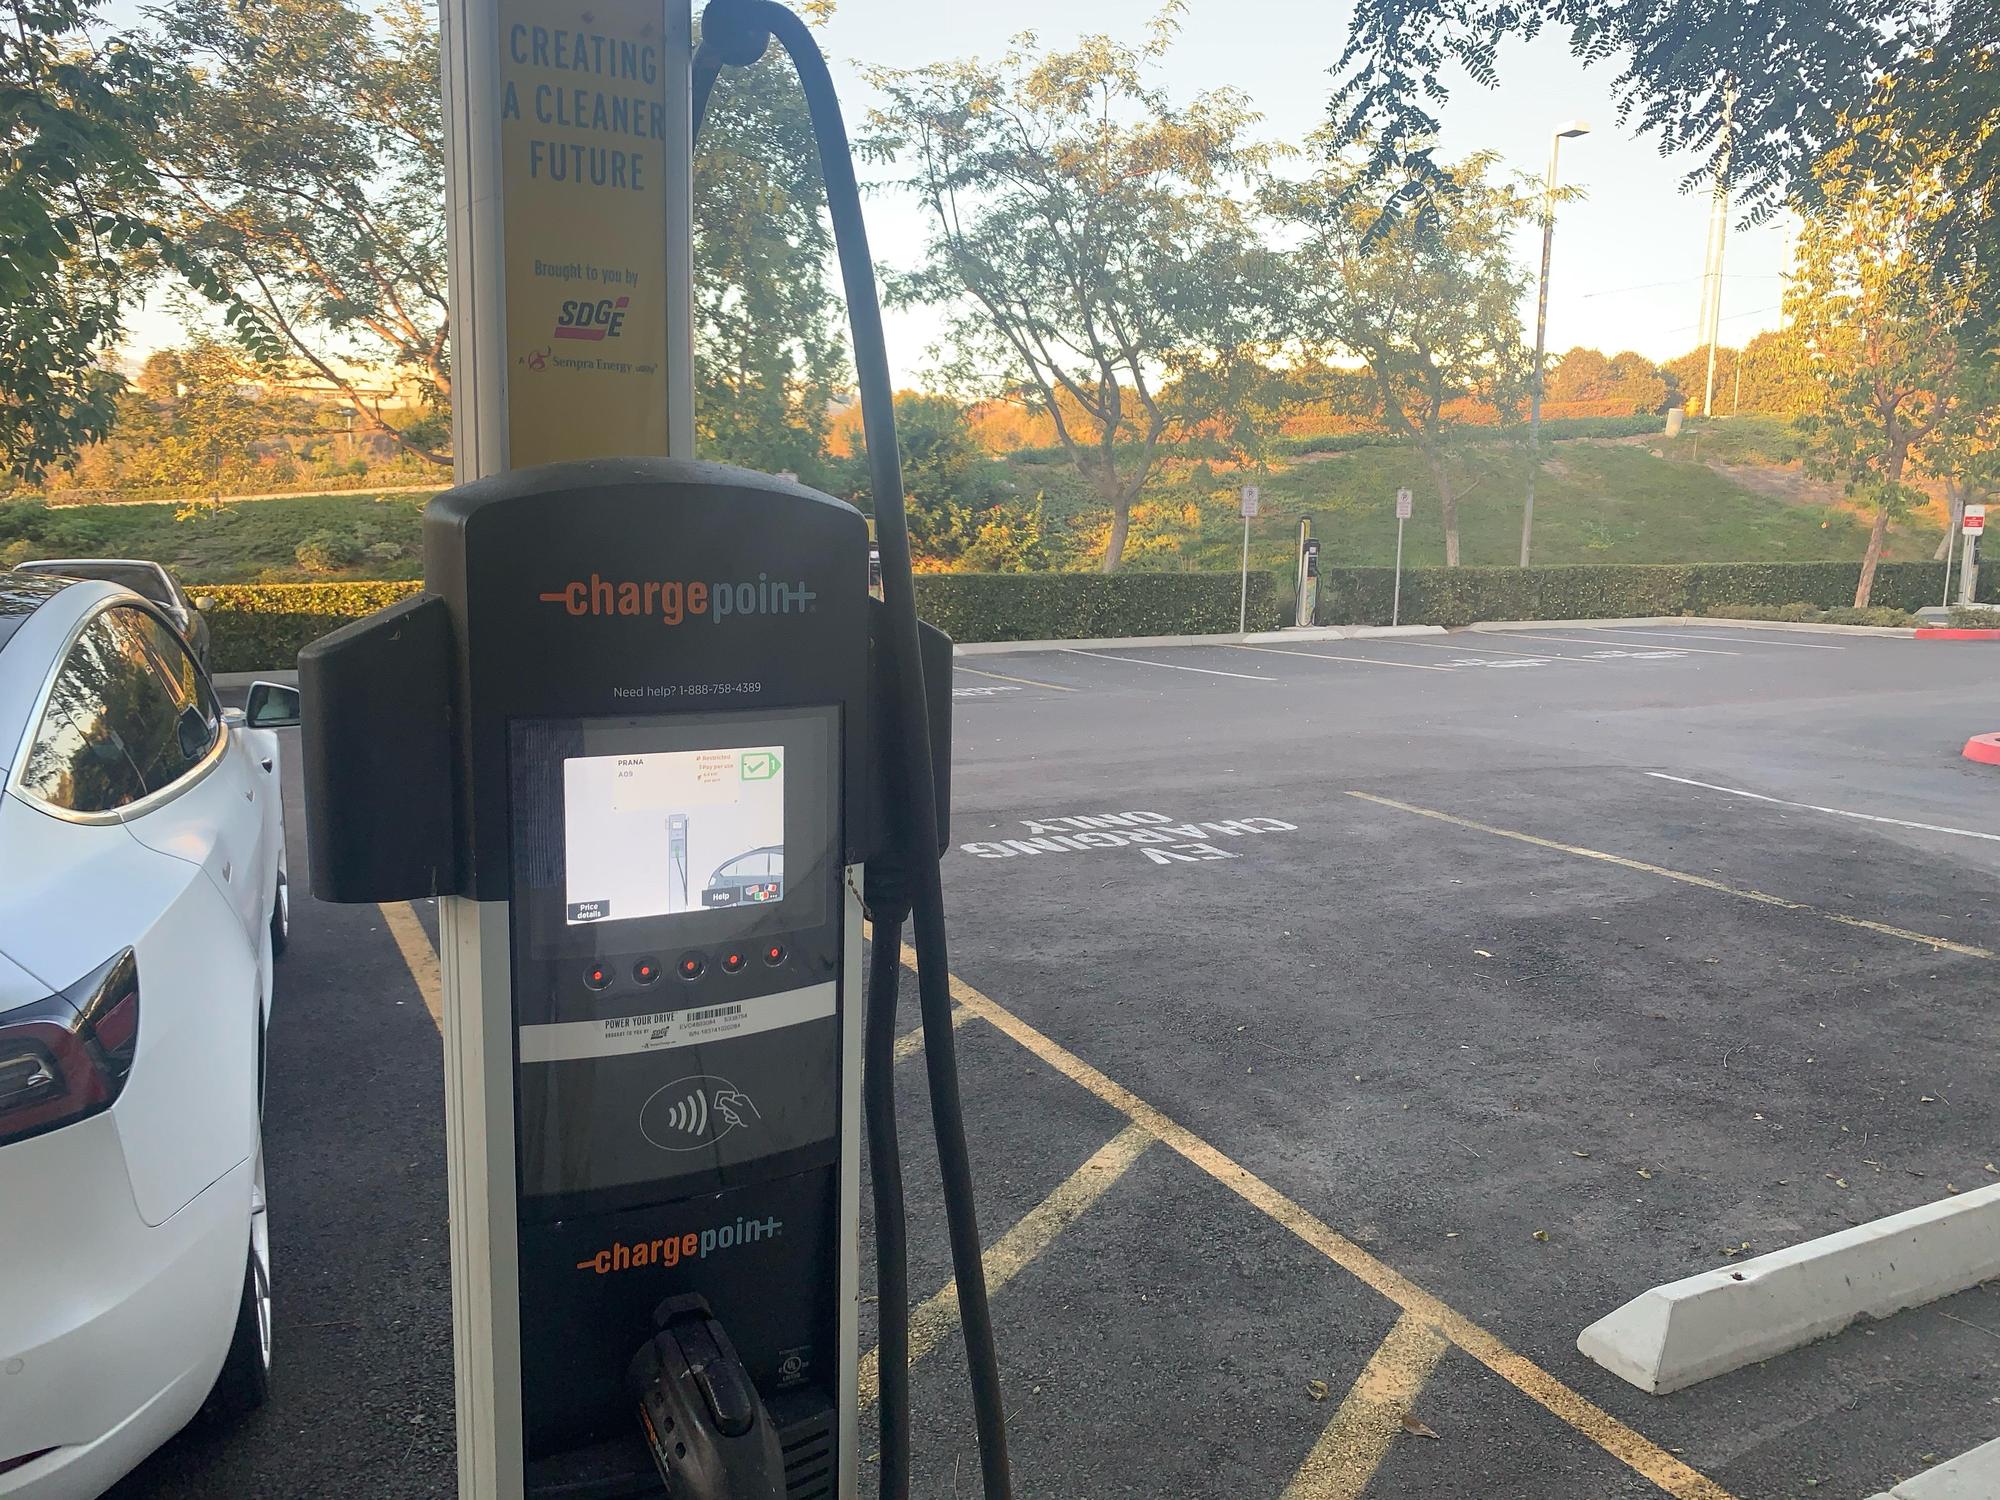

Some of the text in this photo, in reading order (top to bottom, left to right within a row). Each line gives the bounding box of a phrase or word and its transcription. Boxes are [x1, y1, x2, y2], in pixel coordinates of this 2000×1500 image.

[511, 23, 657, 85] CREATING
[502, 81, 665, 141] A CLEANER
[531, 140, 644, 191] FUTURE
[535, 260, 639, 288] Brought to you by
[552, 356, 594, 371] Sempra
[597, 359, 632, 373] Energy
[540, 572, 816, 625] chargepoint
[614, 682, 762, 698] Need help? 1-888-758-4389
[1019, 811, 1173, 834] ONLY
[960, 817, 1298, 858] CHARGING
[1140, 843, 1244, 864] EV
[580, 903, 599, 911] Price
[712, 892, 730, 901] Help
[577, 910, 602, 919] details
[605, 1012, 674, 1029] POWER YOUR DRIVE
[577, 1216, 783, 1274] chargepoint
